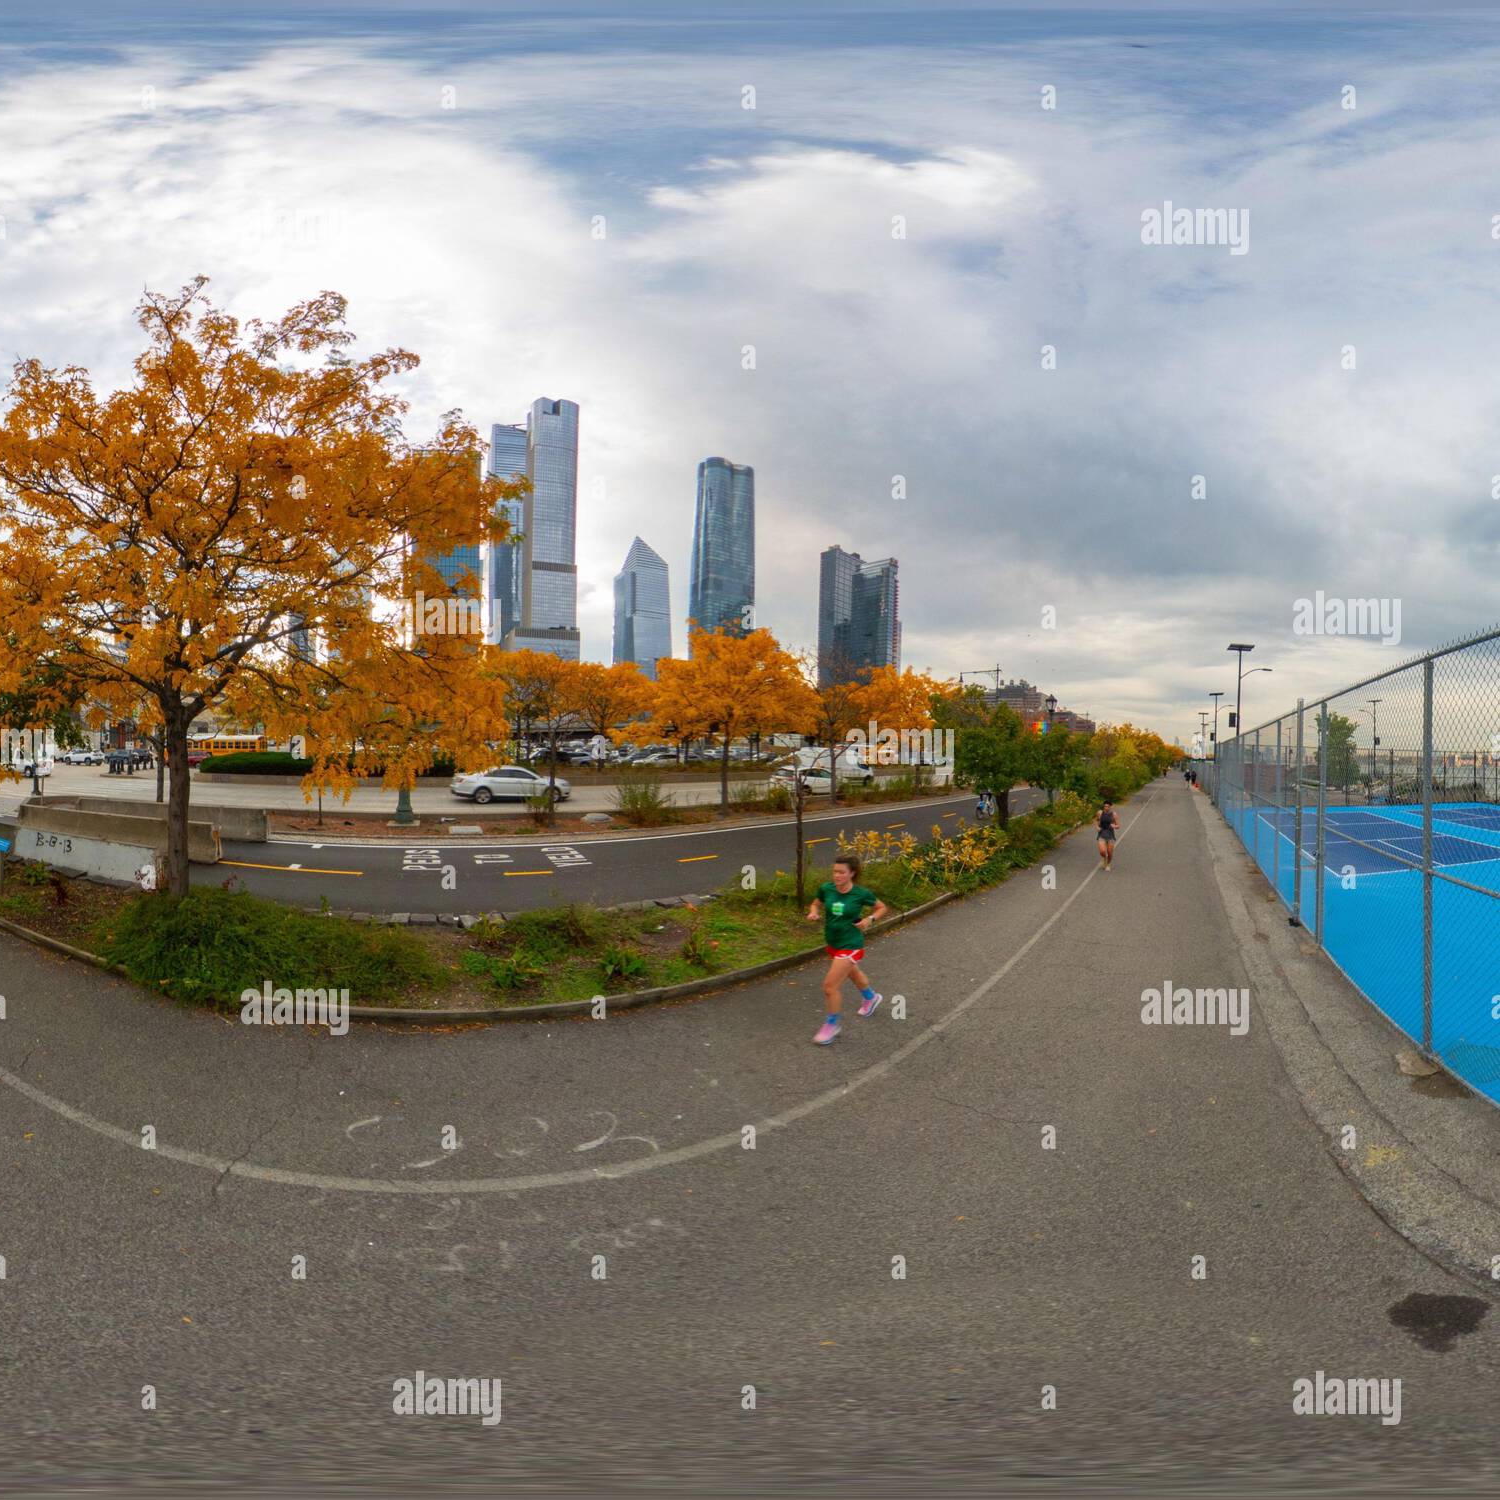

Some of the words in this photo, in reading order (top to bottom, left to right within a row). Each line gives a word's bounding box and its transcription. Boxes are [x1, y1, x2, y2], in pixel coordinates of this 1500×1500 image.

[402, 849, 441, 871] PEDS
[473, 854, 514, 864] TO
[540, 846, 593, 868] YIELD
